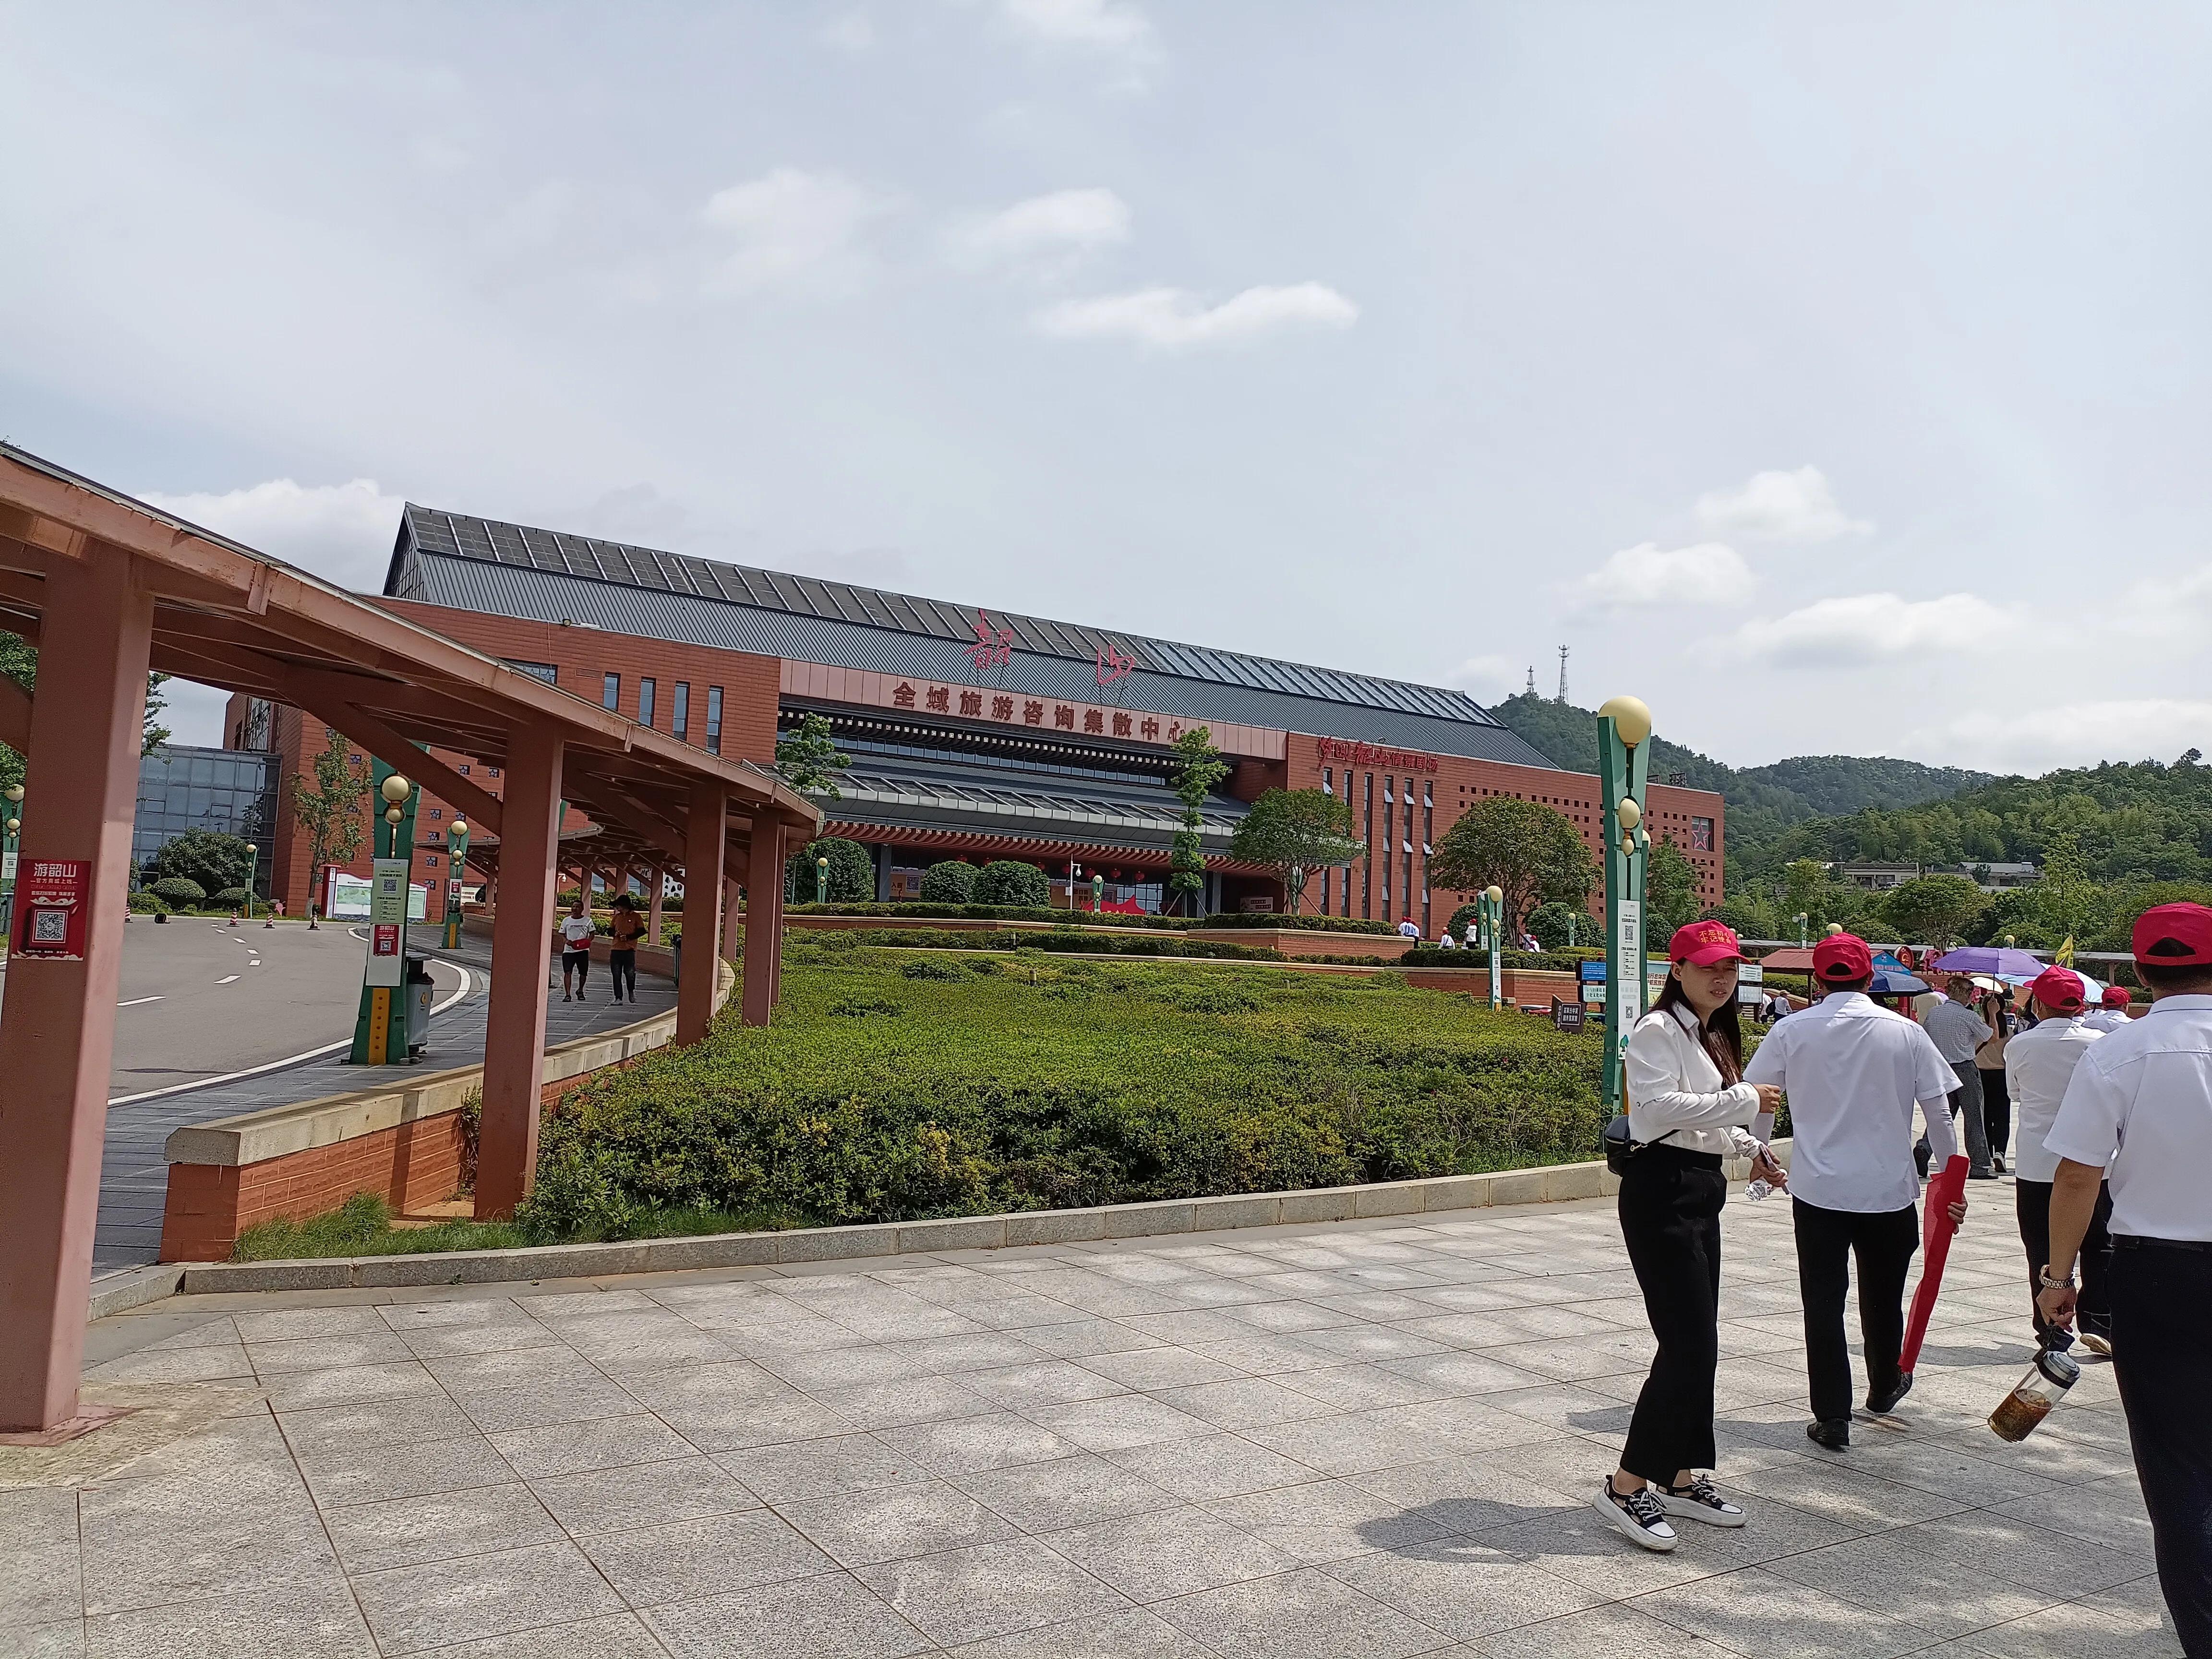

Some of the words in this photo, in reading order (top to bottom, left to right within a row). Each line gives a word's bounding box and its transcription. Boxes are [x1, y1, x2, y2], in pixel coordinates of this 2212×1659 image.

[893, 681, 1186, 743] 全域旅游咨询集散中心
[34, 863, 77, 878] 游韶山
[1699, 929, 1730, 938] 不忘初心
